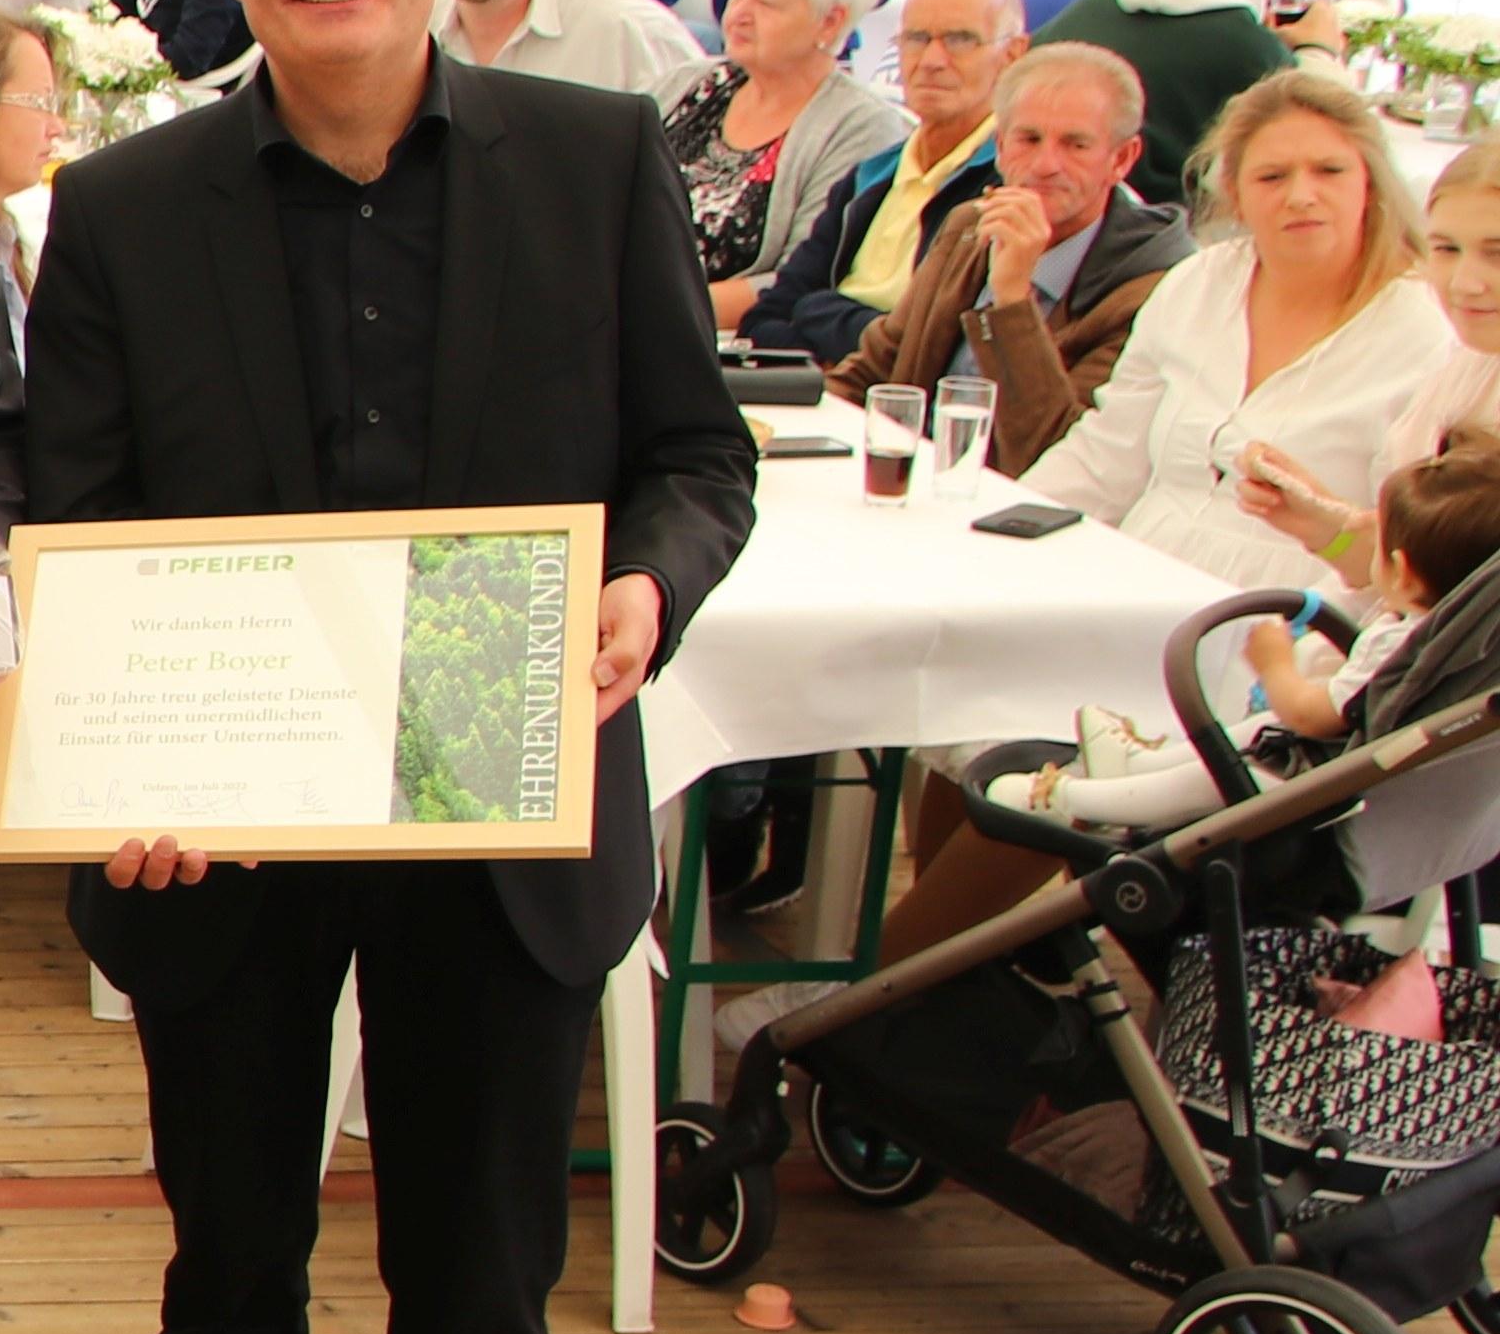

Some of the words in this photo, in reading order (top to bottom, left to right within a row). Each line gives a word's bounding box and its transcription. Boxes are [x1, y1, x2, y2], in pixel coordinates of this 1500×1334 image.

[168, 553, 296, 576] PFEIFER
[131, 616, 163, 632] Wir
[168, 614, 234, 632] danken
[239, 613, 293, 630] Herrn
[125, 651, 199, 674] Peter
[208, 649, 292, 677] Boyer
[519, 536, 566, 821] EHRENURKUNDE
[54, 691, 81, 706] für
[85, 692, 106, 705] 30
[110, 690, 156, 707] Jahre
[161, 691, 197, 704] treu
[202, 689, 283, 707] geleistete
[288, 687, 358, 702] Dienste
[82, 711, 118, 725] und
[122, 710, 179, 725] seinen
[185, 706, 323, 723] unermüdlichen
[58, 731, 122, 747] Einsatz
[126, 730, 151, 745] für
[158, 731, 208, 744] unser
[214, 727, 344, 744] Unternehmen.
